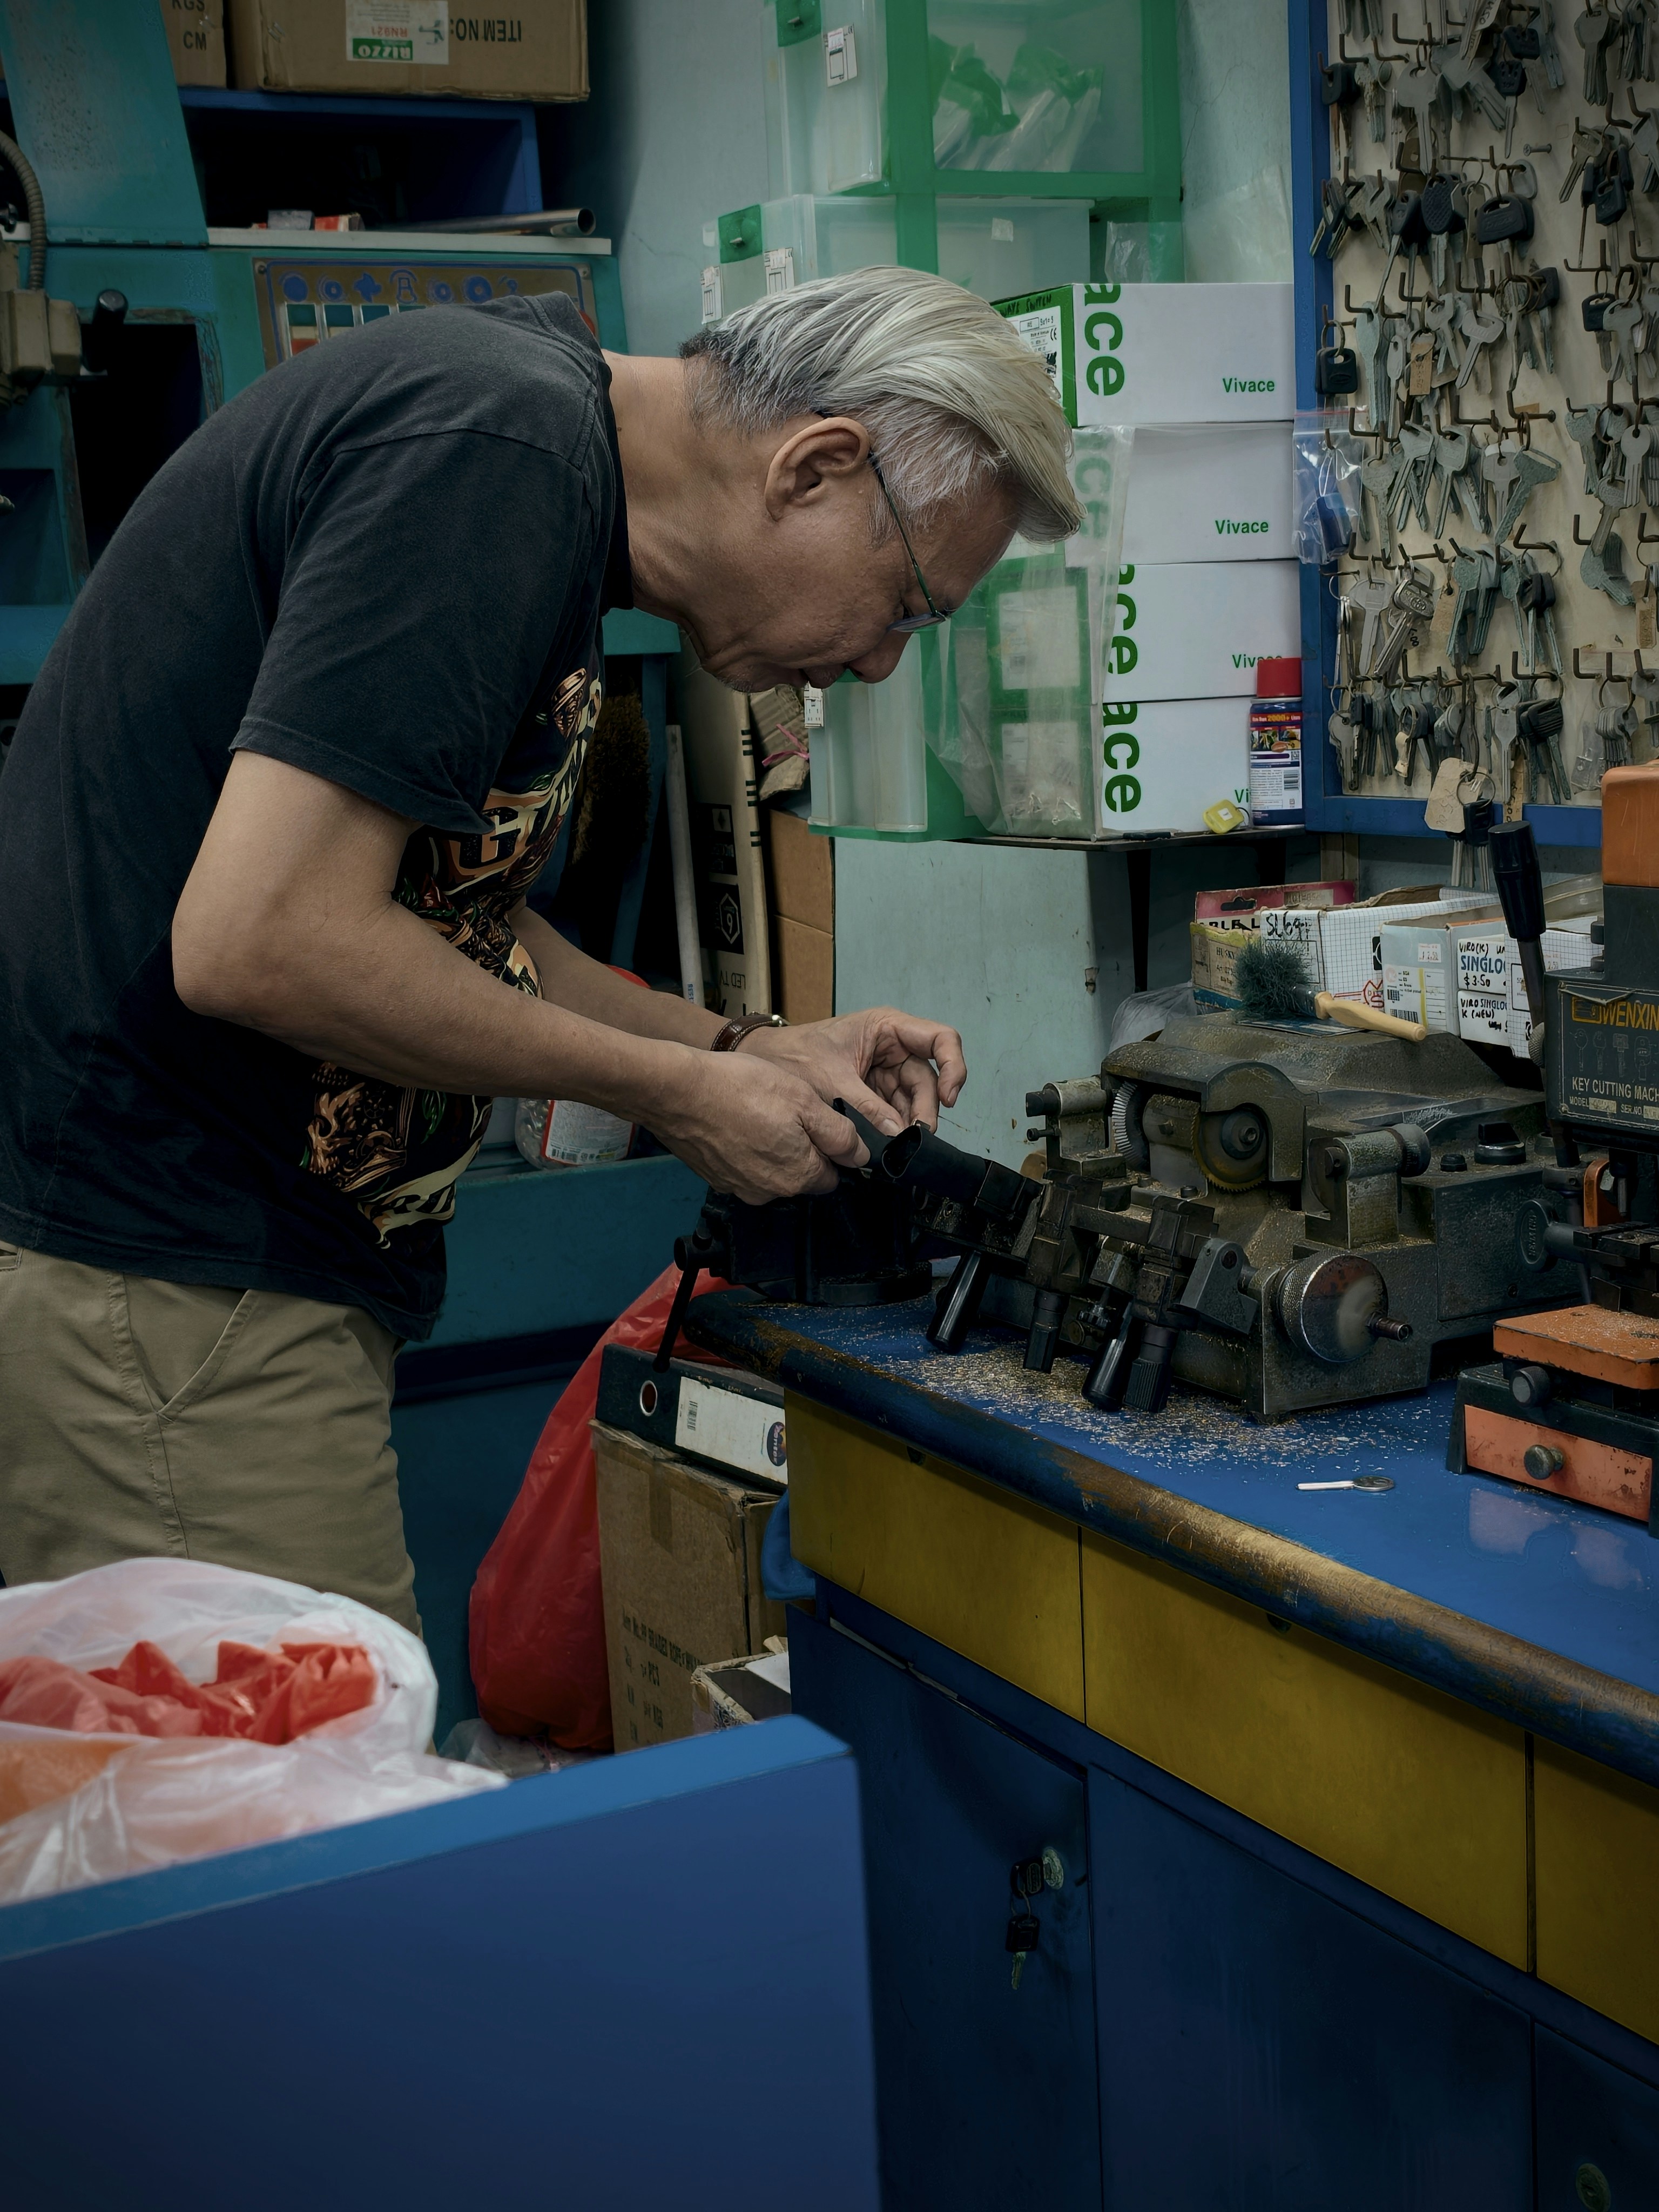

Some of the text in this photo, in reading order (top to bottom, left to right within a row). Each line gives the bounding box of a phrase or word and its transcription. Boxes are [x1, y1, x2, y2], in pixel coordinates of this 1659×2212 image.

[450, 18, 522, 42] ITEM NO:
[183, 31, 207, 51] CM
[358, 45, 411, 59] RIZZO
[1223, 377, 1275, 393] Vivace
[1215, 520, 1269, 534] Vivace
[1232, 653, 1283, 668] Viv
[720, 970, 746, 990] LED TV
[1461, 999, 1478, 1008] VIRO
[1462, 1009, 1467, 1018] K
[1572, 1077, 1590, 1091] KEY
[1593, 1080, 1631, 1098] CUTTING
[1569, 1096, 1589, 1107] MODEL
